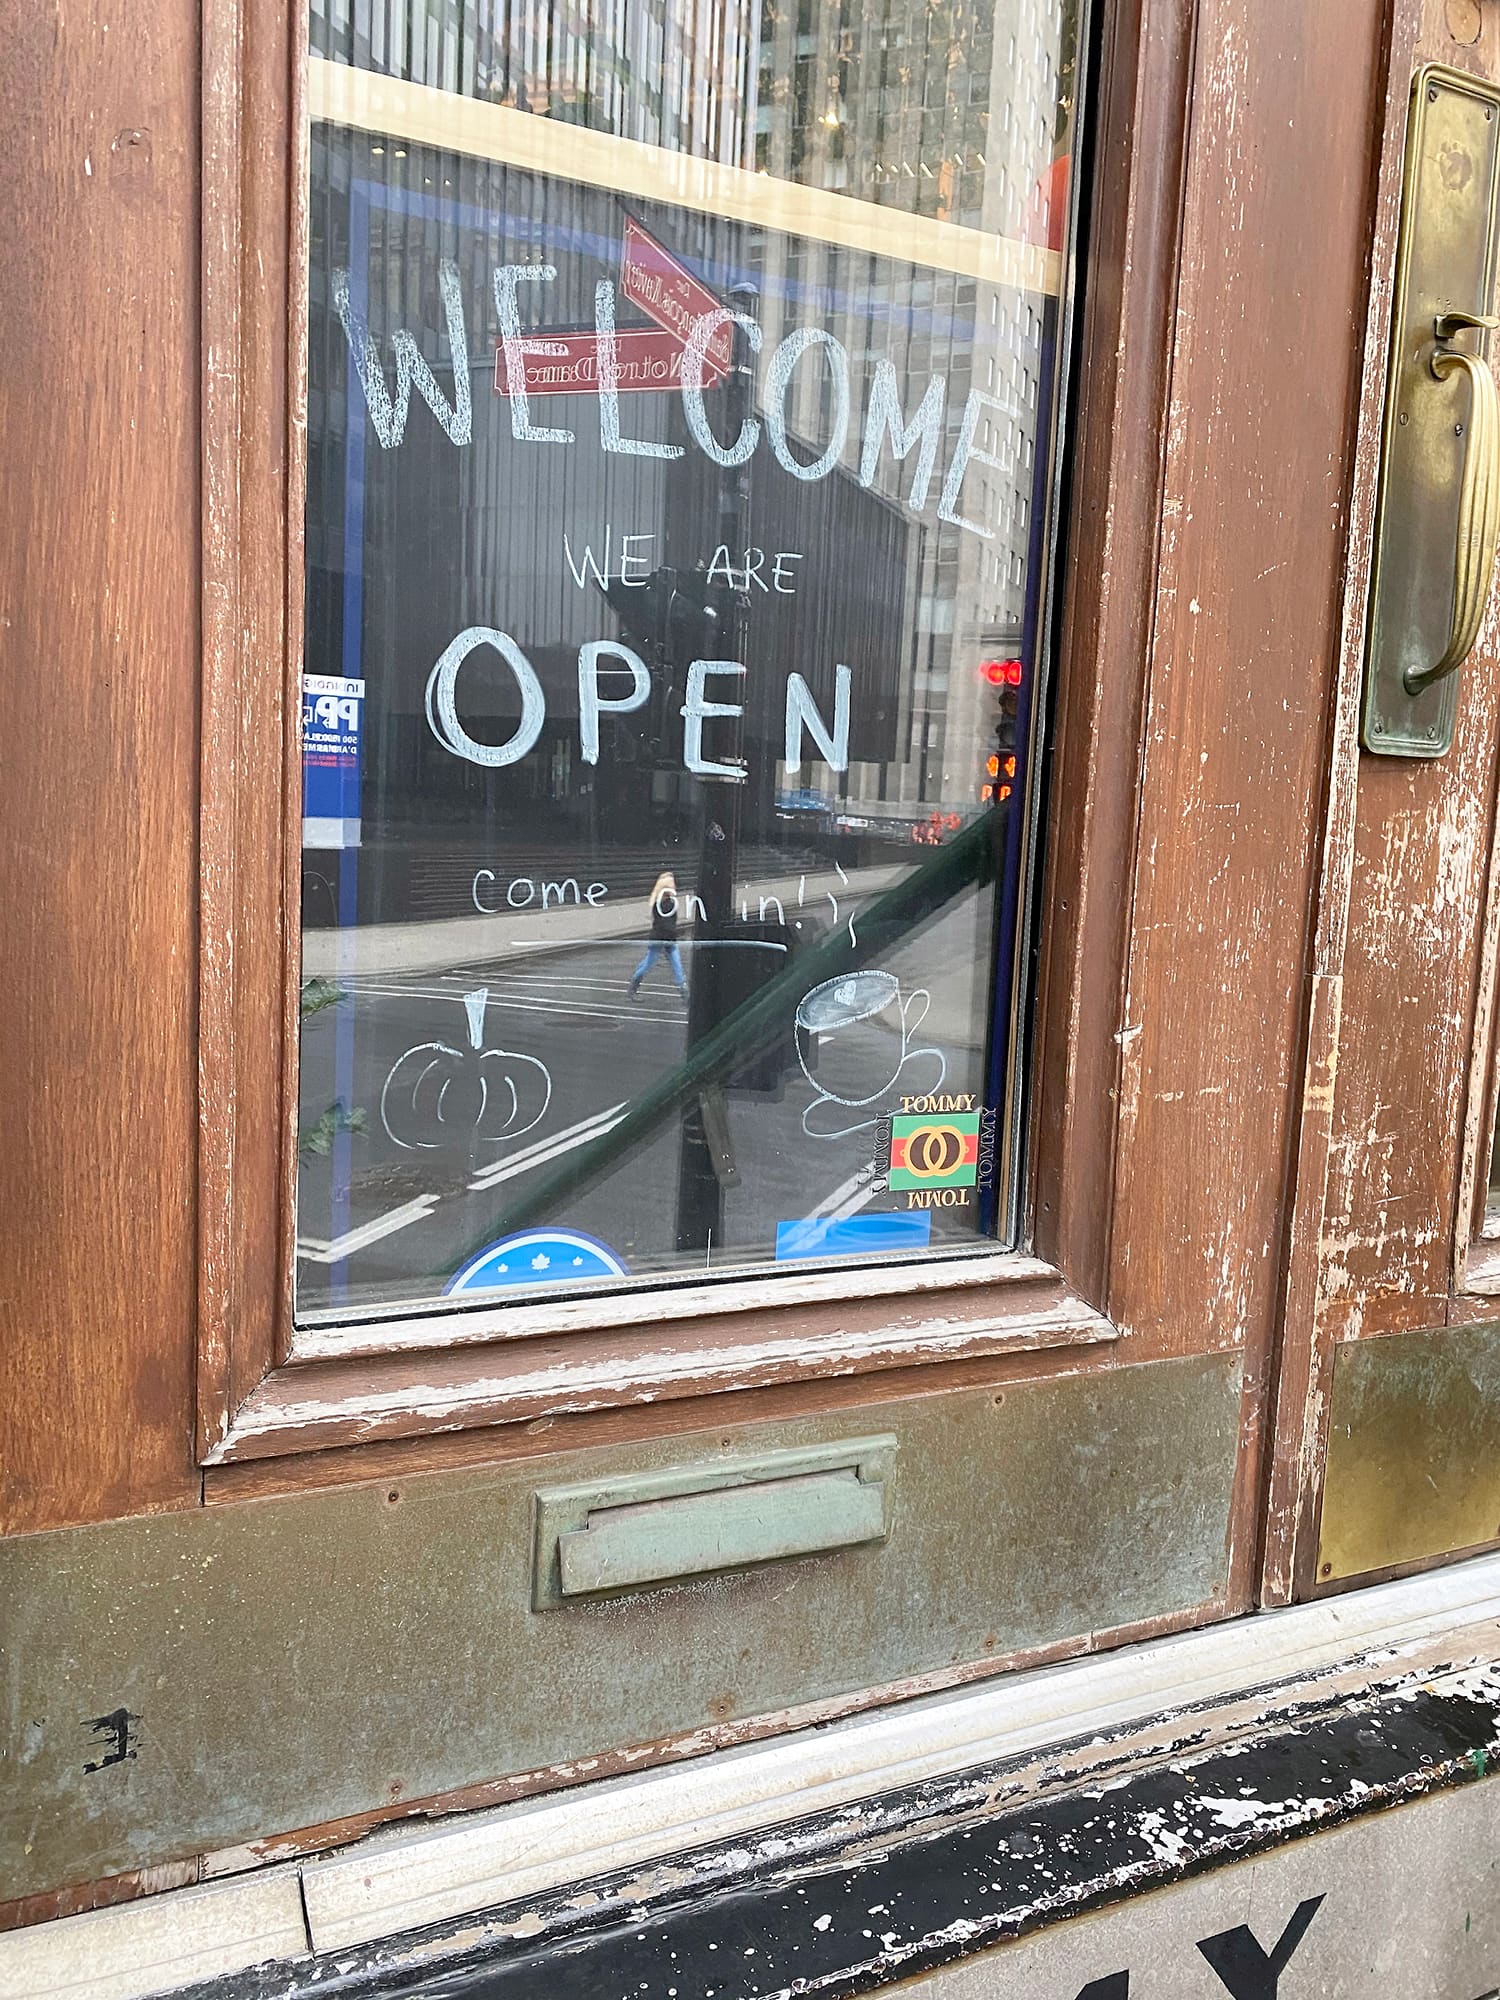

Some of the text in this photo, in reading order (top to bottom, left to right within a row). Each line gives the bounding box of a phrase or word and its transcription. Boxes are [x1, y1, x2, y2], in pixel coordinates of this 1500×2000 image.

[332, 256, 1022, 538] WELCOME
[563, 524, 804, 593] WE ARE
[425, 626, 852, 777] OPEN
[655, 887, 708, 922] on
[741, 875, 806, 929] in!
[900, 1094, 976, 1114] TOMMY
[977, 1106, 997, 1193] TOMMY
